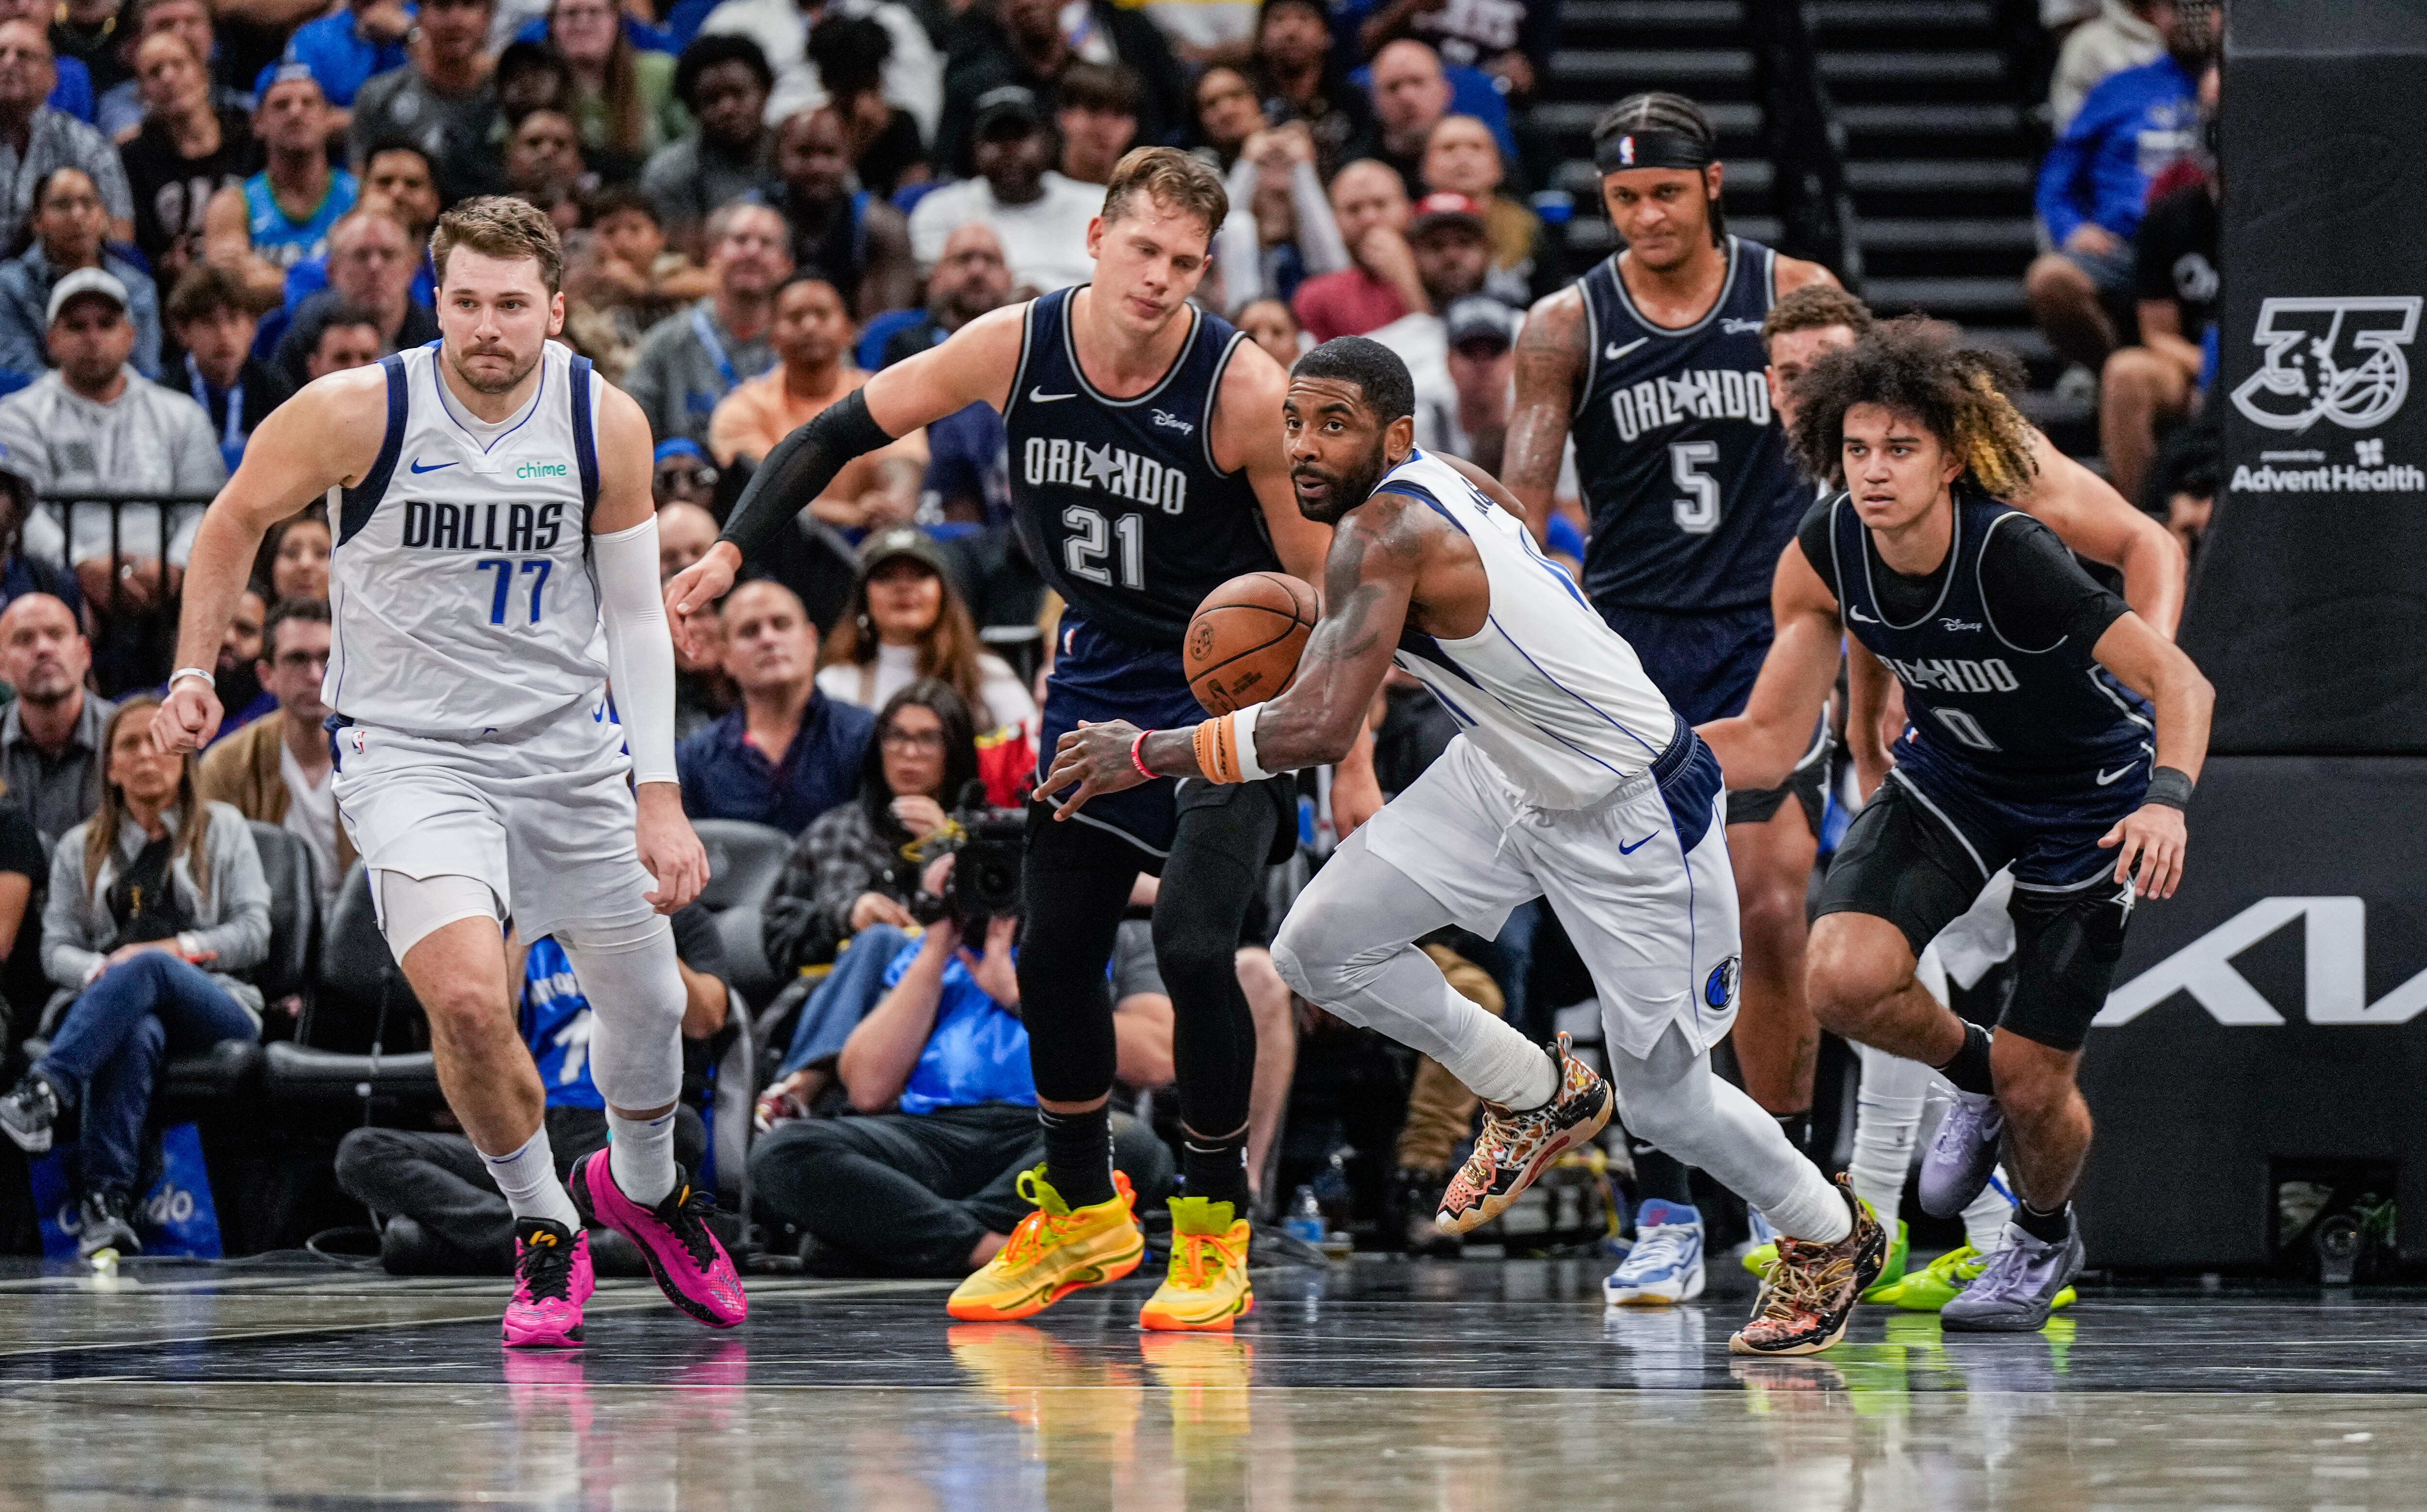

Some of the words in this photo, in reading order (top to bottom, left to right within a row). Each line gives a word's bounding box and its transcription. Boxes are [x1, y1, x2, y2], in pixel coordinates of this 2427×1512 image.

[2230, 296, 2423, 433] 35
[1151, 408, 1194, 435] Disney
[516, 462, 567, 480] chime
[1668, 440, 1722, 534] 5
[2230, 464, 2426, 492] AdventHealth
[402, 499, 564, 553] DALLAS
[1063, 504, 1145, 591] 21
[476, 558, 552, 626] 77
[1938, 617, 1982, 633] Disney
[1929, 706, 2003, 752] 0
